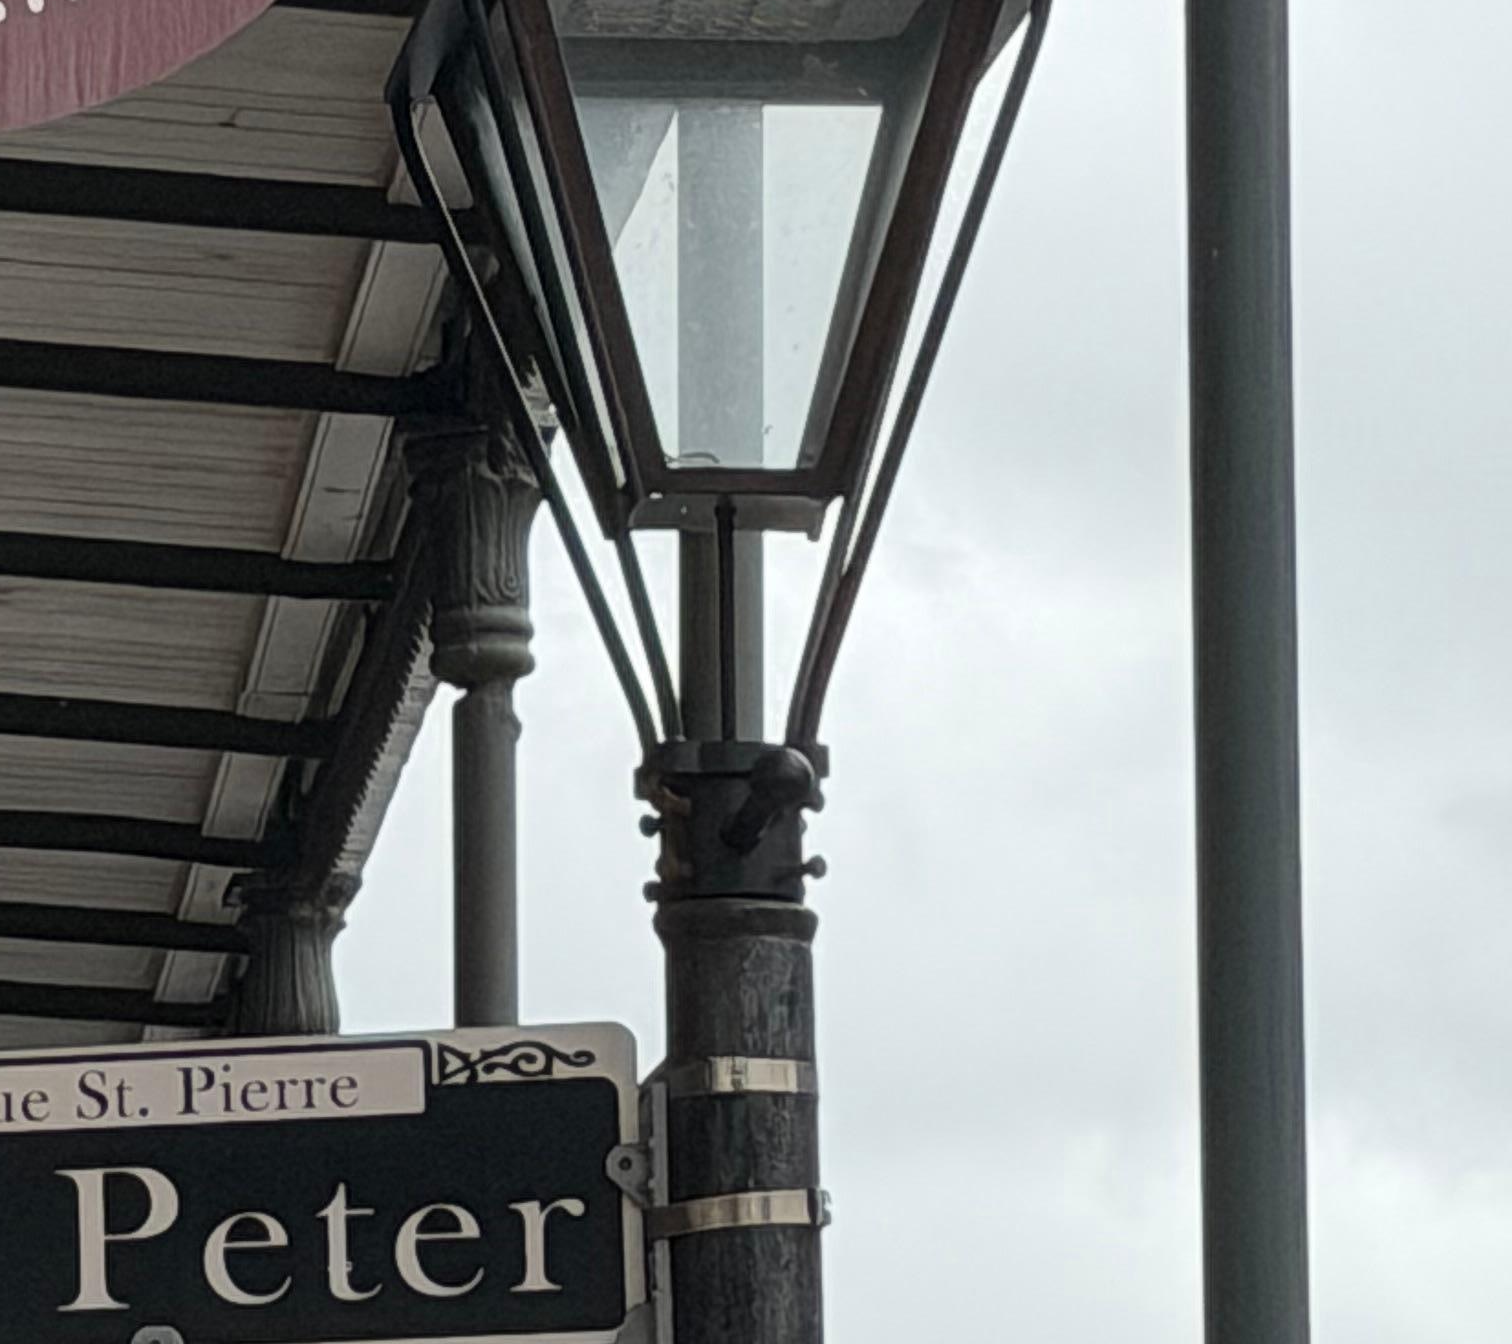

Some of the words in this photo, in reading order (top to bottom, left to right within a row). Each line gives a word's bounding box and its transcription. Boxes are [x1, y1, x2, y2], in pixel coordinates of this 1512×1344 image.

[75, 1070, 151, 1122] St.
[177, 1062, 360, 1117] Pierre
[54, 1164, 586, 1313] Peter
